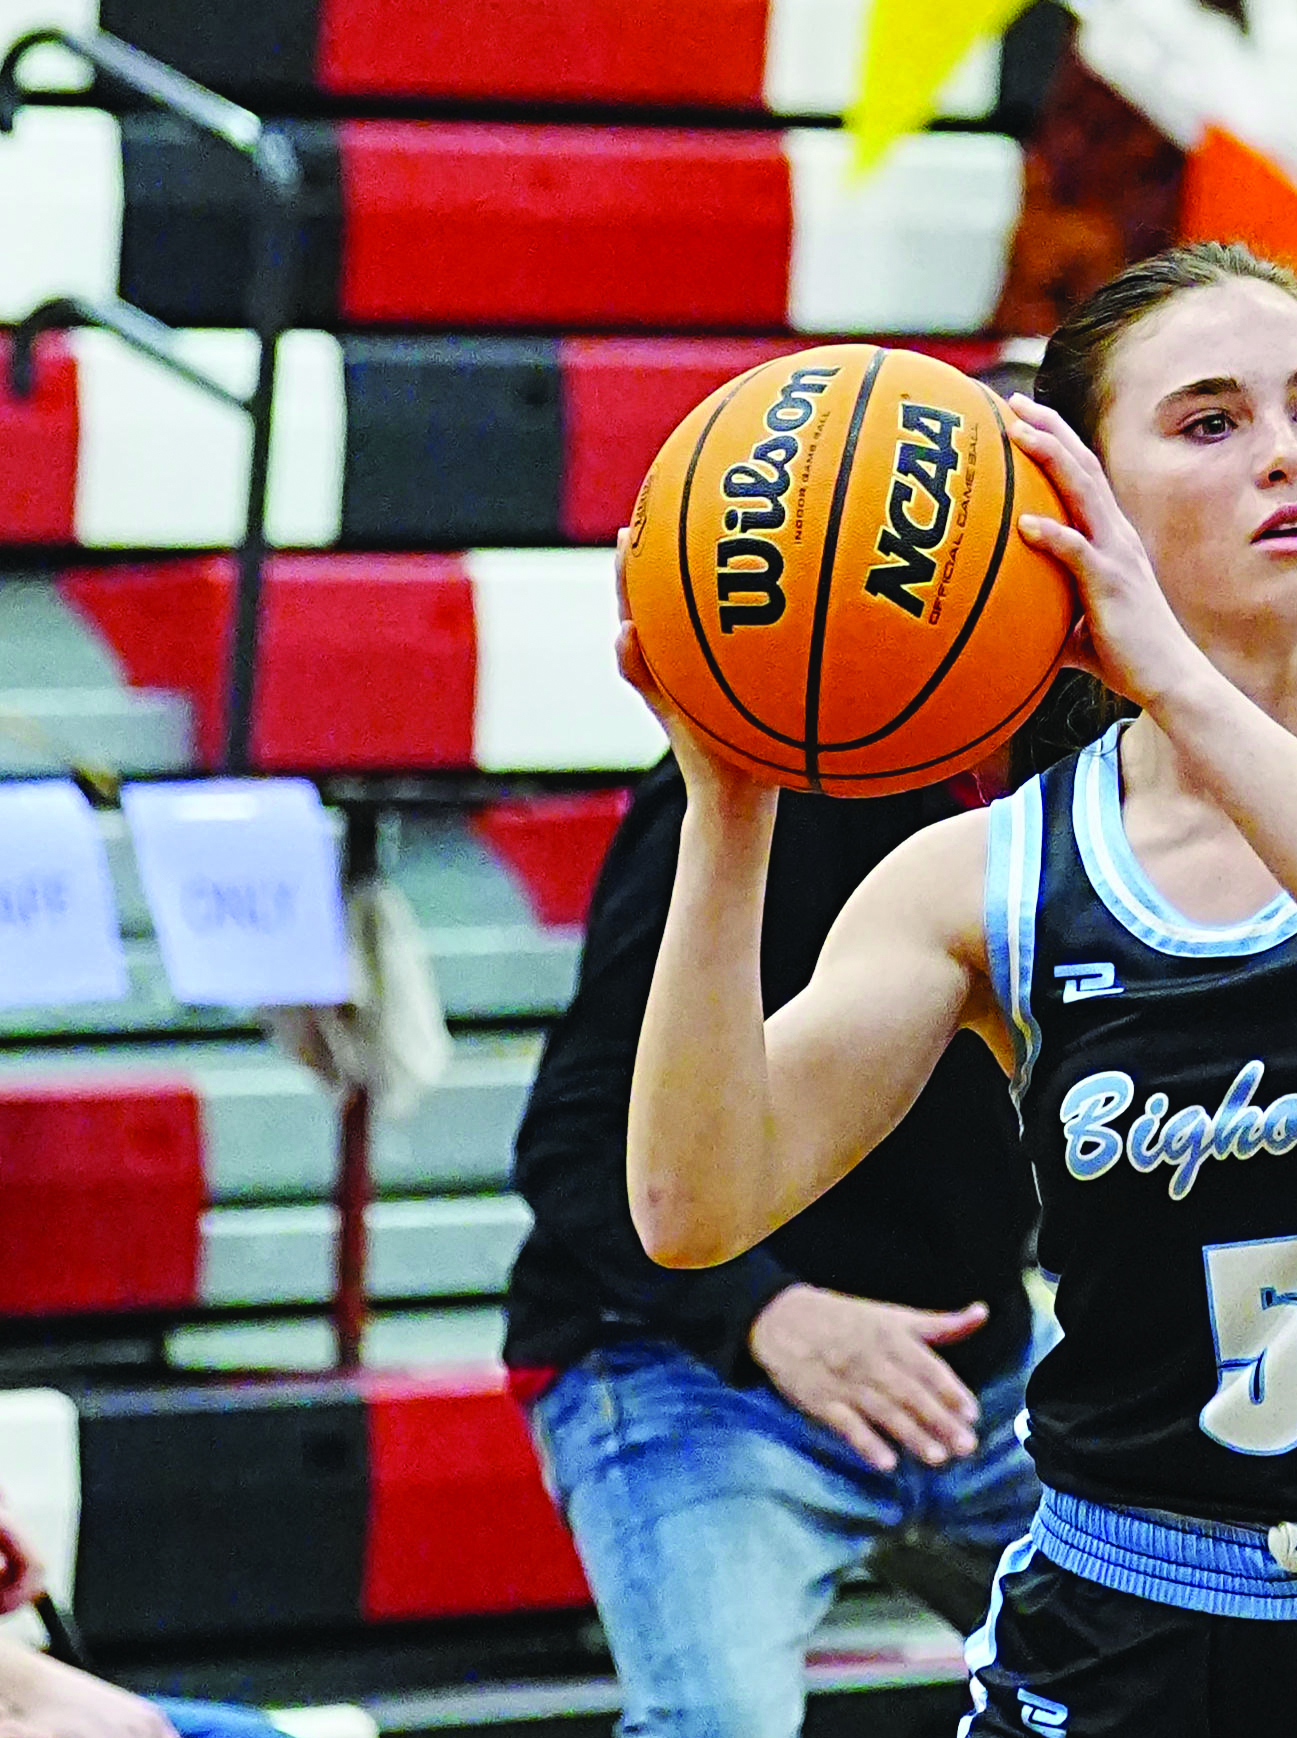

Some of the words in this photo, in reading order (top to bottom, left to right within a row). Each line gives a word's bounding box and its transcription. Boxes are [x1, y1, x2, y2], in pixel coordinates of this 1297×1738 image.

[717, 365, 840, 634] Wilson
[864, 400, 963, 621] NCAA
[928, 532, 964, 626] OFFICIAL
